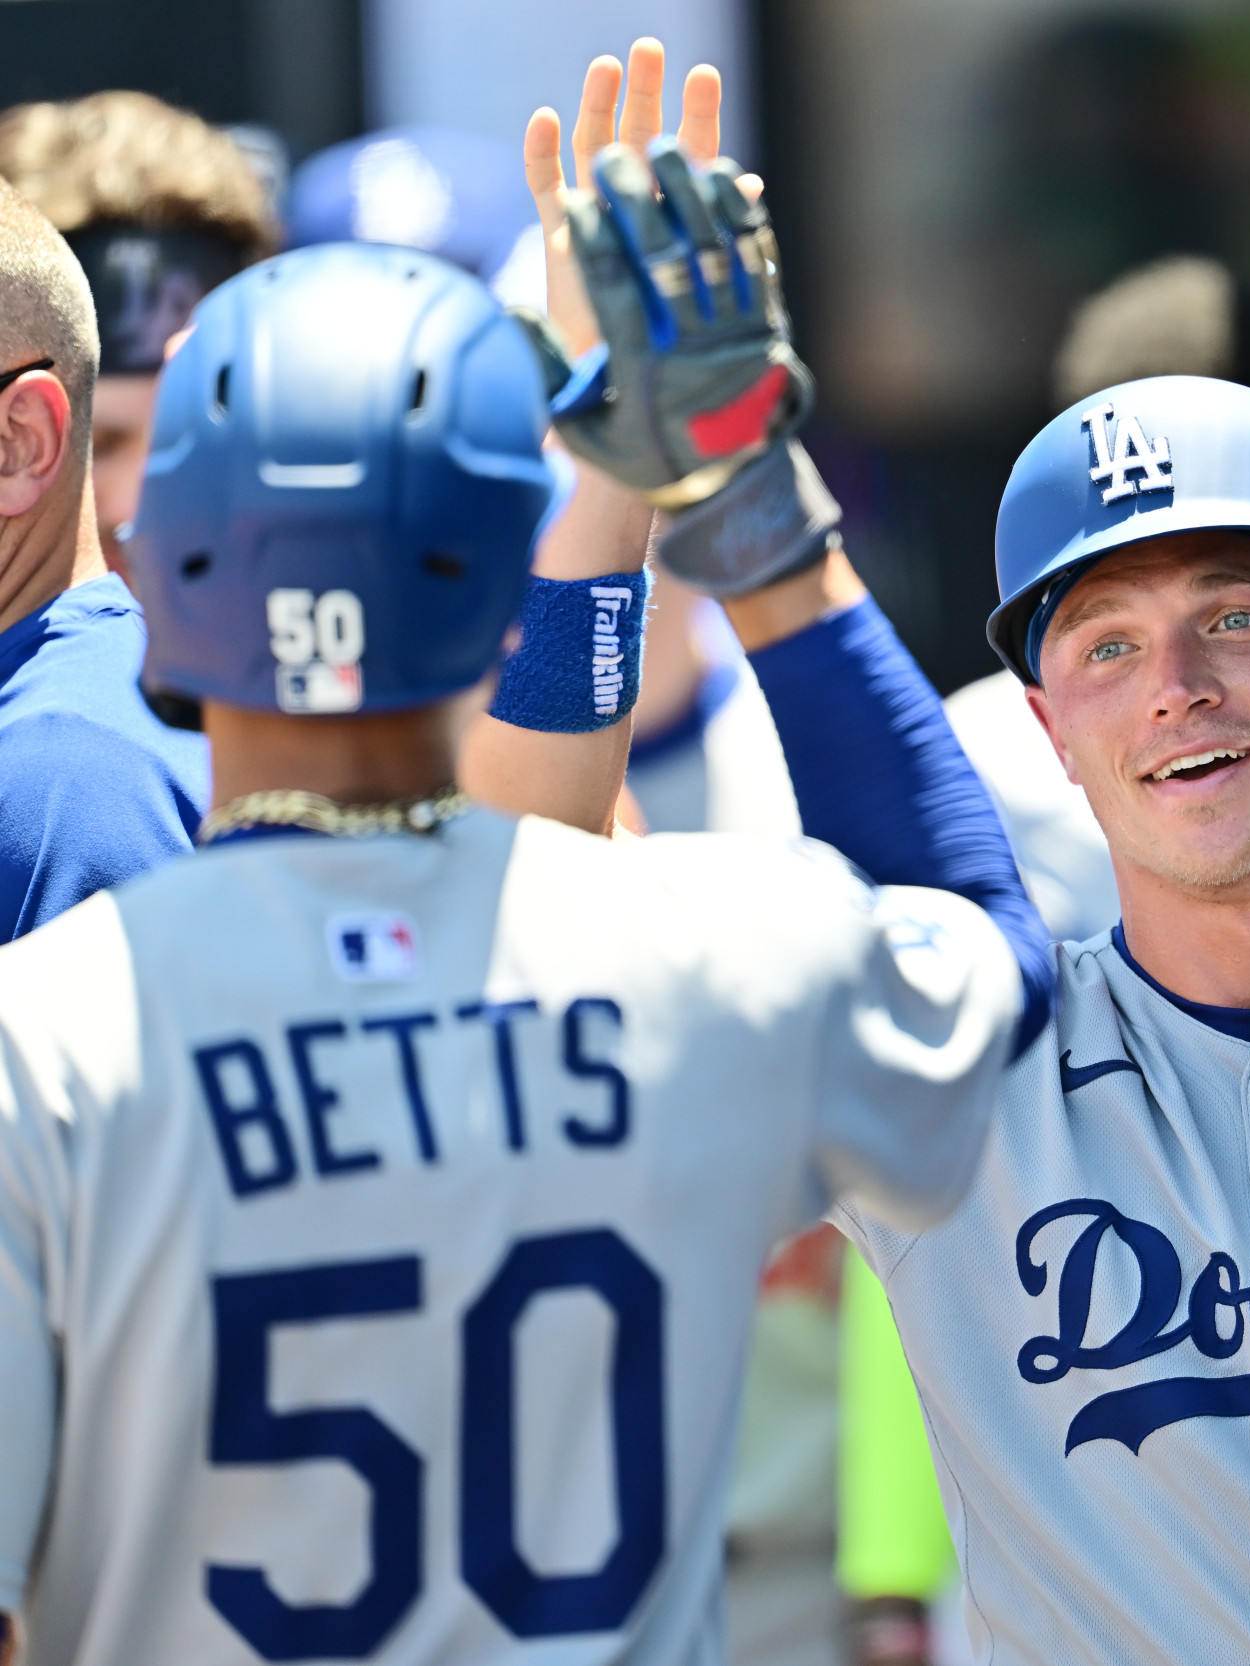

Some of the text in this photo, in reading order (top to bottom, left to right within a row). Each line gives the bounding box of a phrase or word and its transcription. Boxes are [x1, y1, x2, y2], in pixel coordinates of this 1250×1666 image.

[1081, 402, 1173, 506] LA
[266, 587, 364, 667] 50
[194, 996, 631, 1196] BETTS
[205, 1225, 667, 1662] 50
